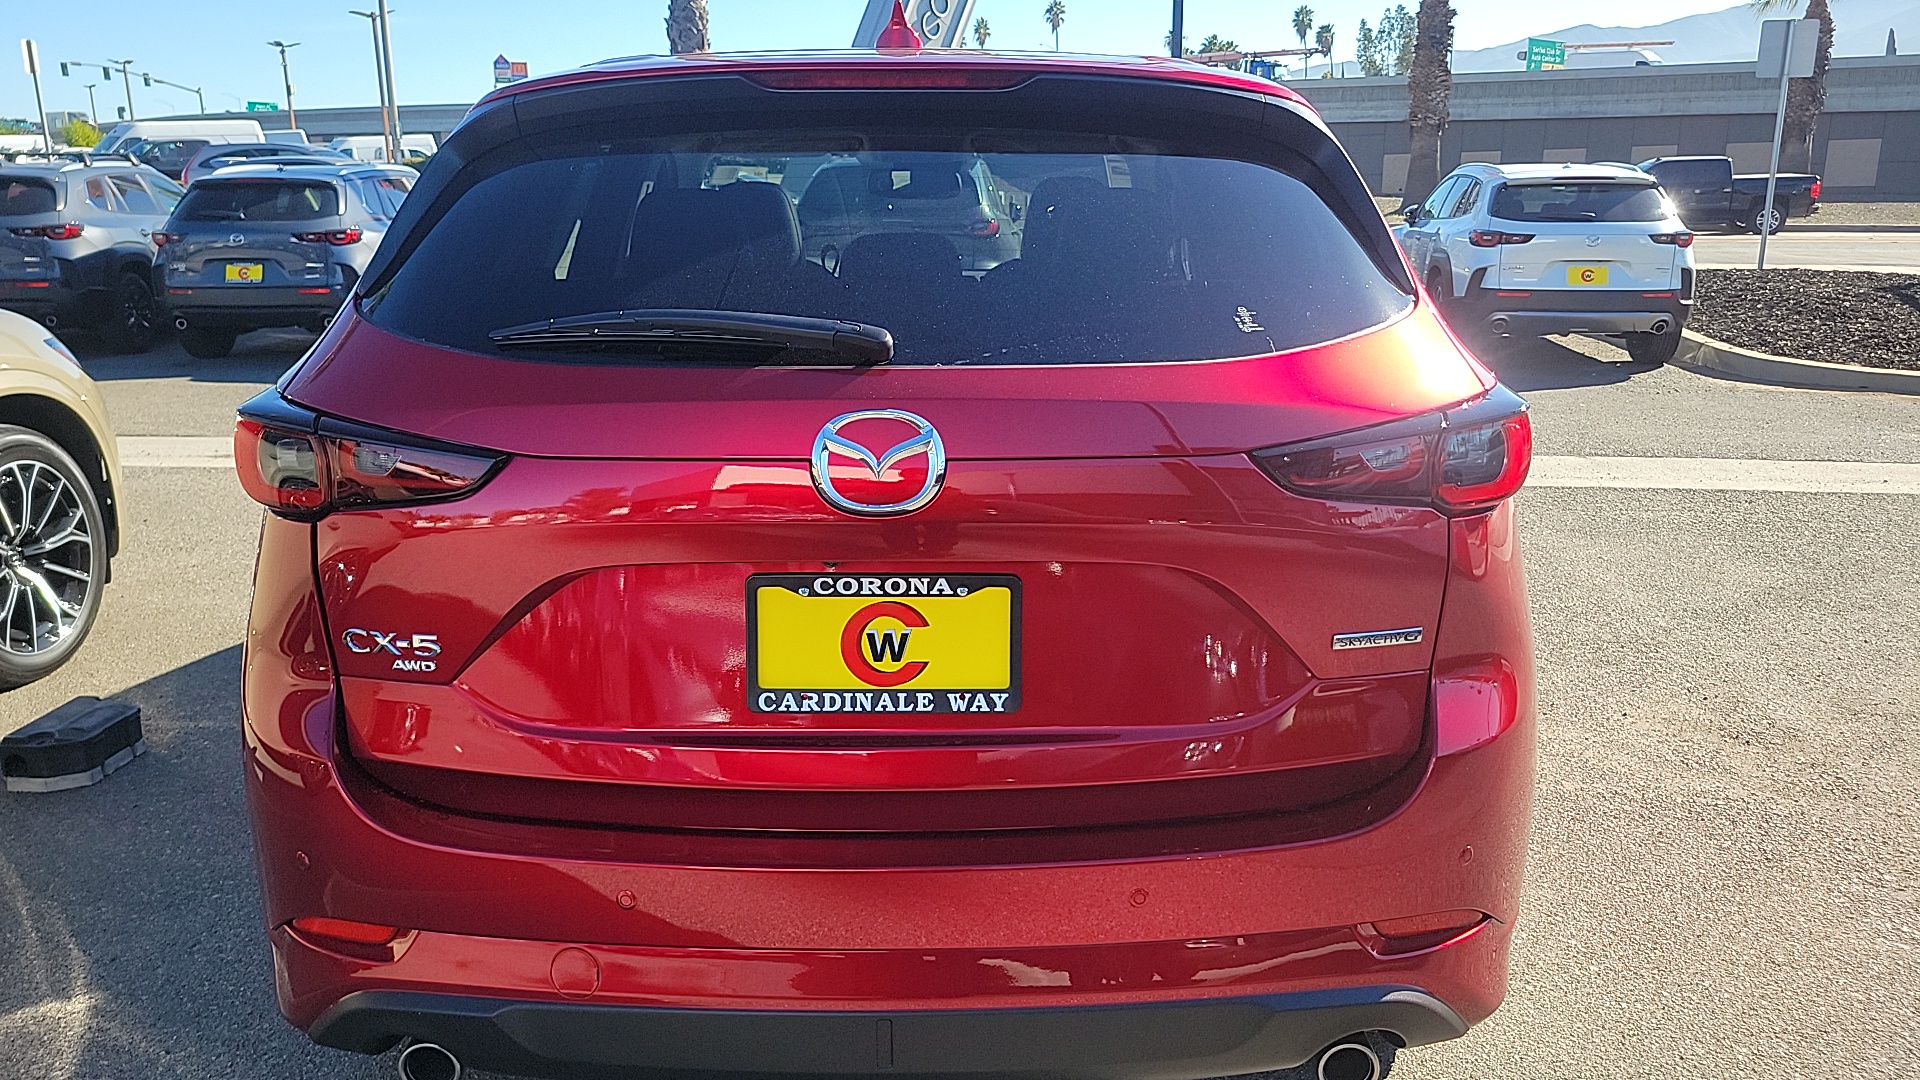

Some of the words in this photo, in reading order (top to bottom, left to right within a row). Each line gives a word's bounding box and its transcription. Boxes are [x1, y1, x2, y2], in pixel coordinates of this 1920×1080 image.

[812, 577, 954, 595] CORONA
[342, 628, 441, 657] CX-5
[391, 659, 437, 672] AWD
[757, 692, 935, 713] CARDINALE
[946, 692, 1010, 712] WAY
